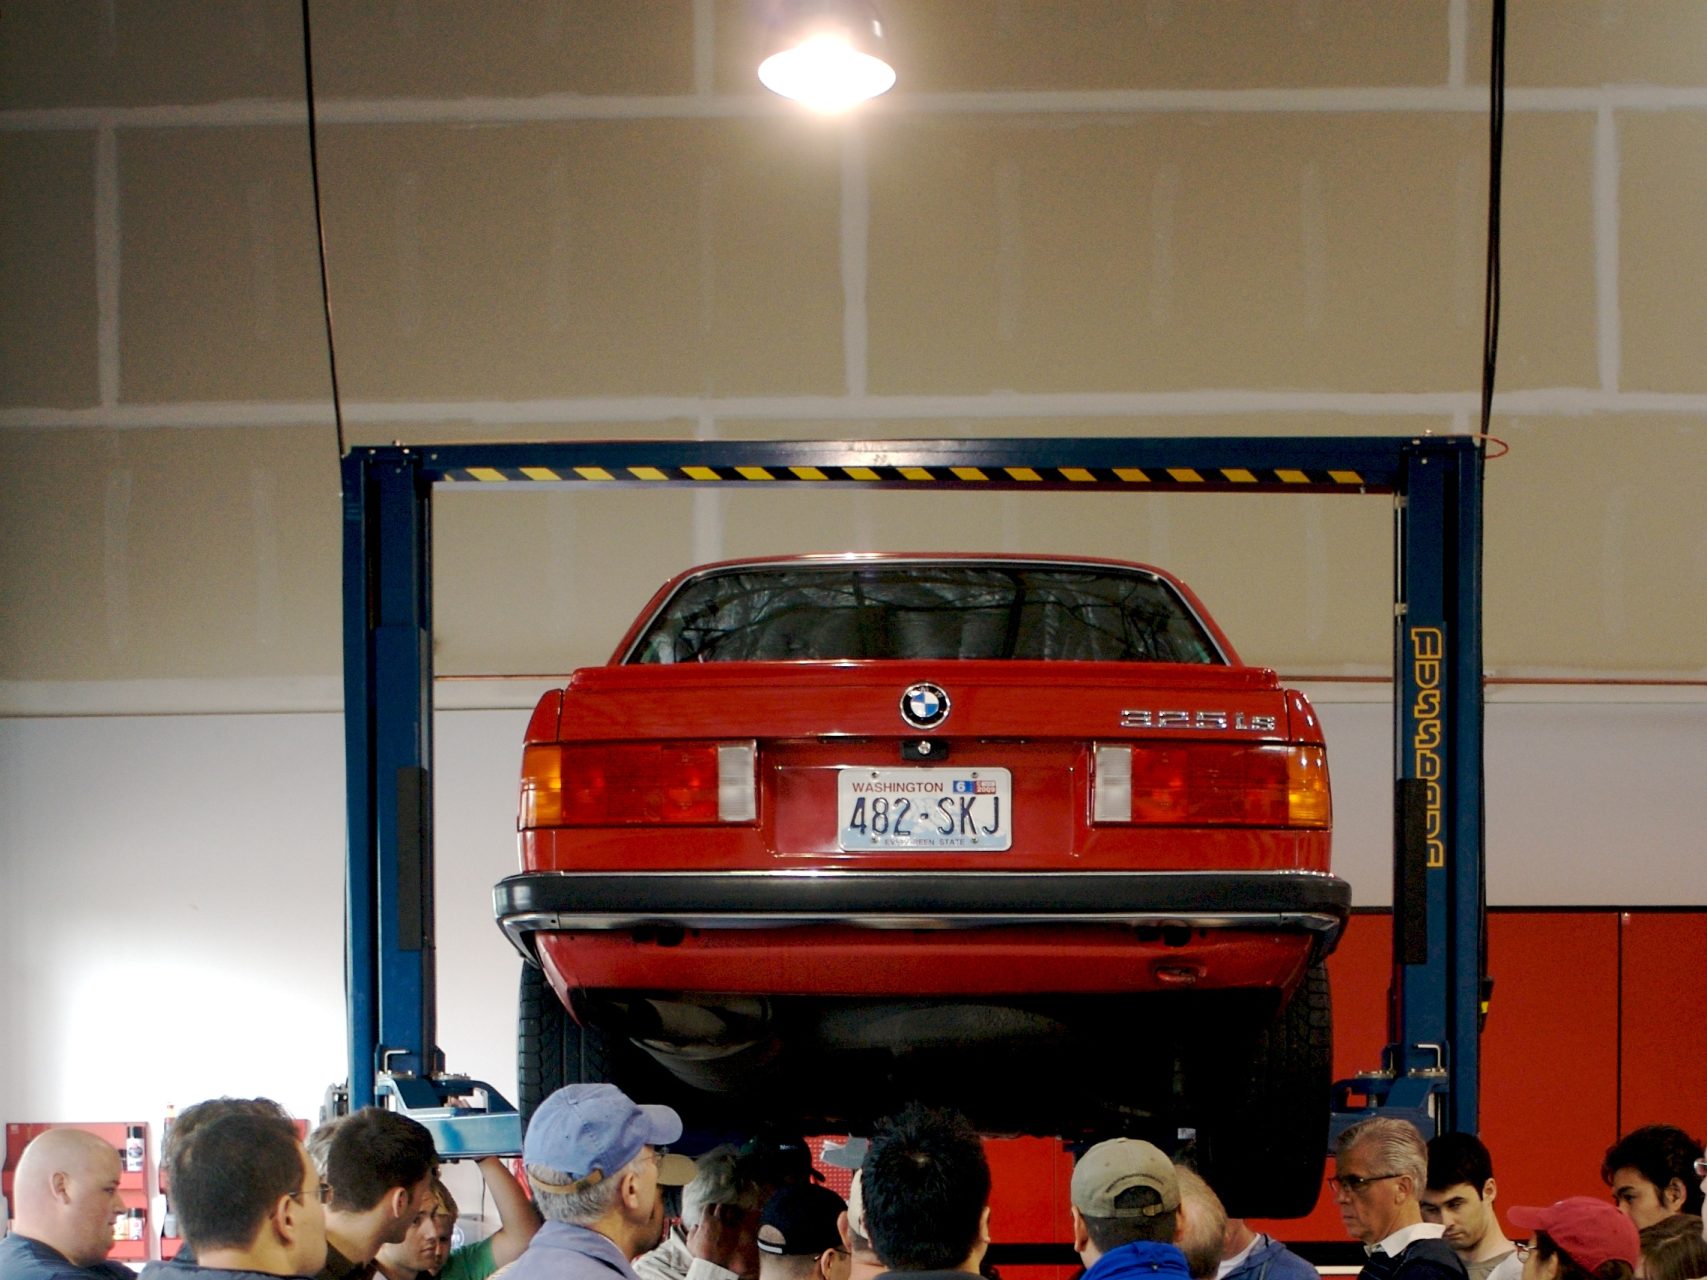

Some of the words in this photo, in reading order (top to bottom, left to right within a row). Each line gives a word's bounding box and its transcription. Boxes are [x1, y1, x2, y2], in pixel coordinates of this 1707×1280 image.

[852, 781, 944, 793] WASHINGTON
[956, 781, 966, 793] 6
[939, 838, 965, 846] STATE
